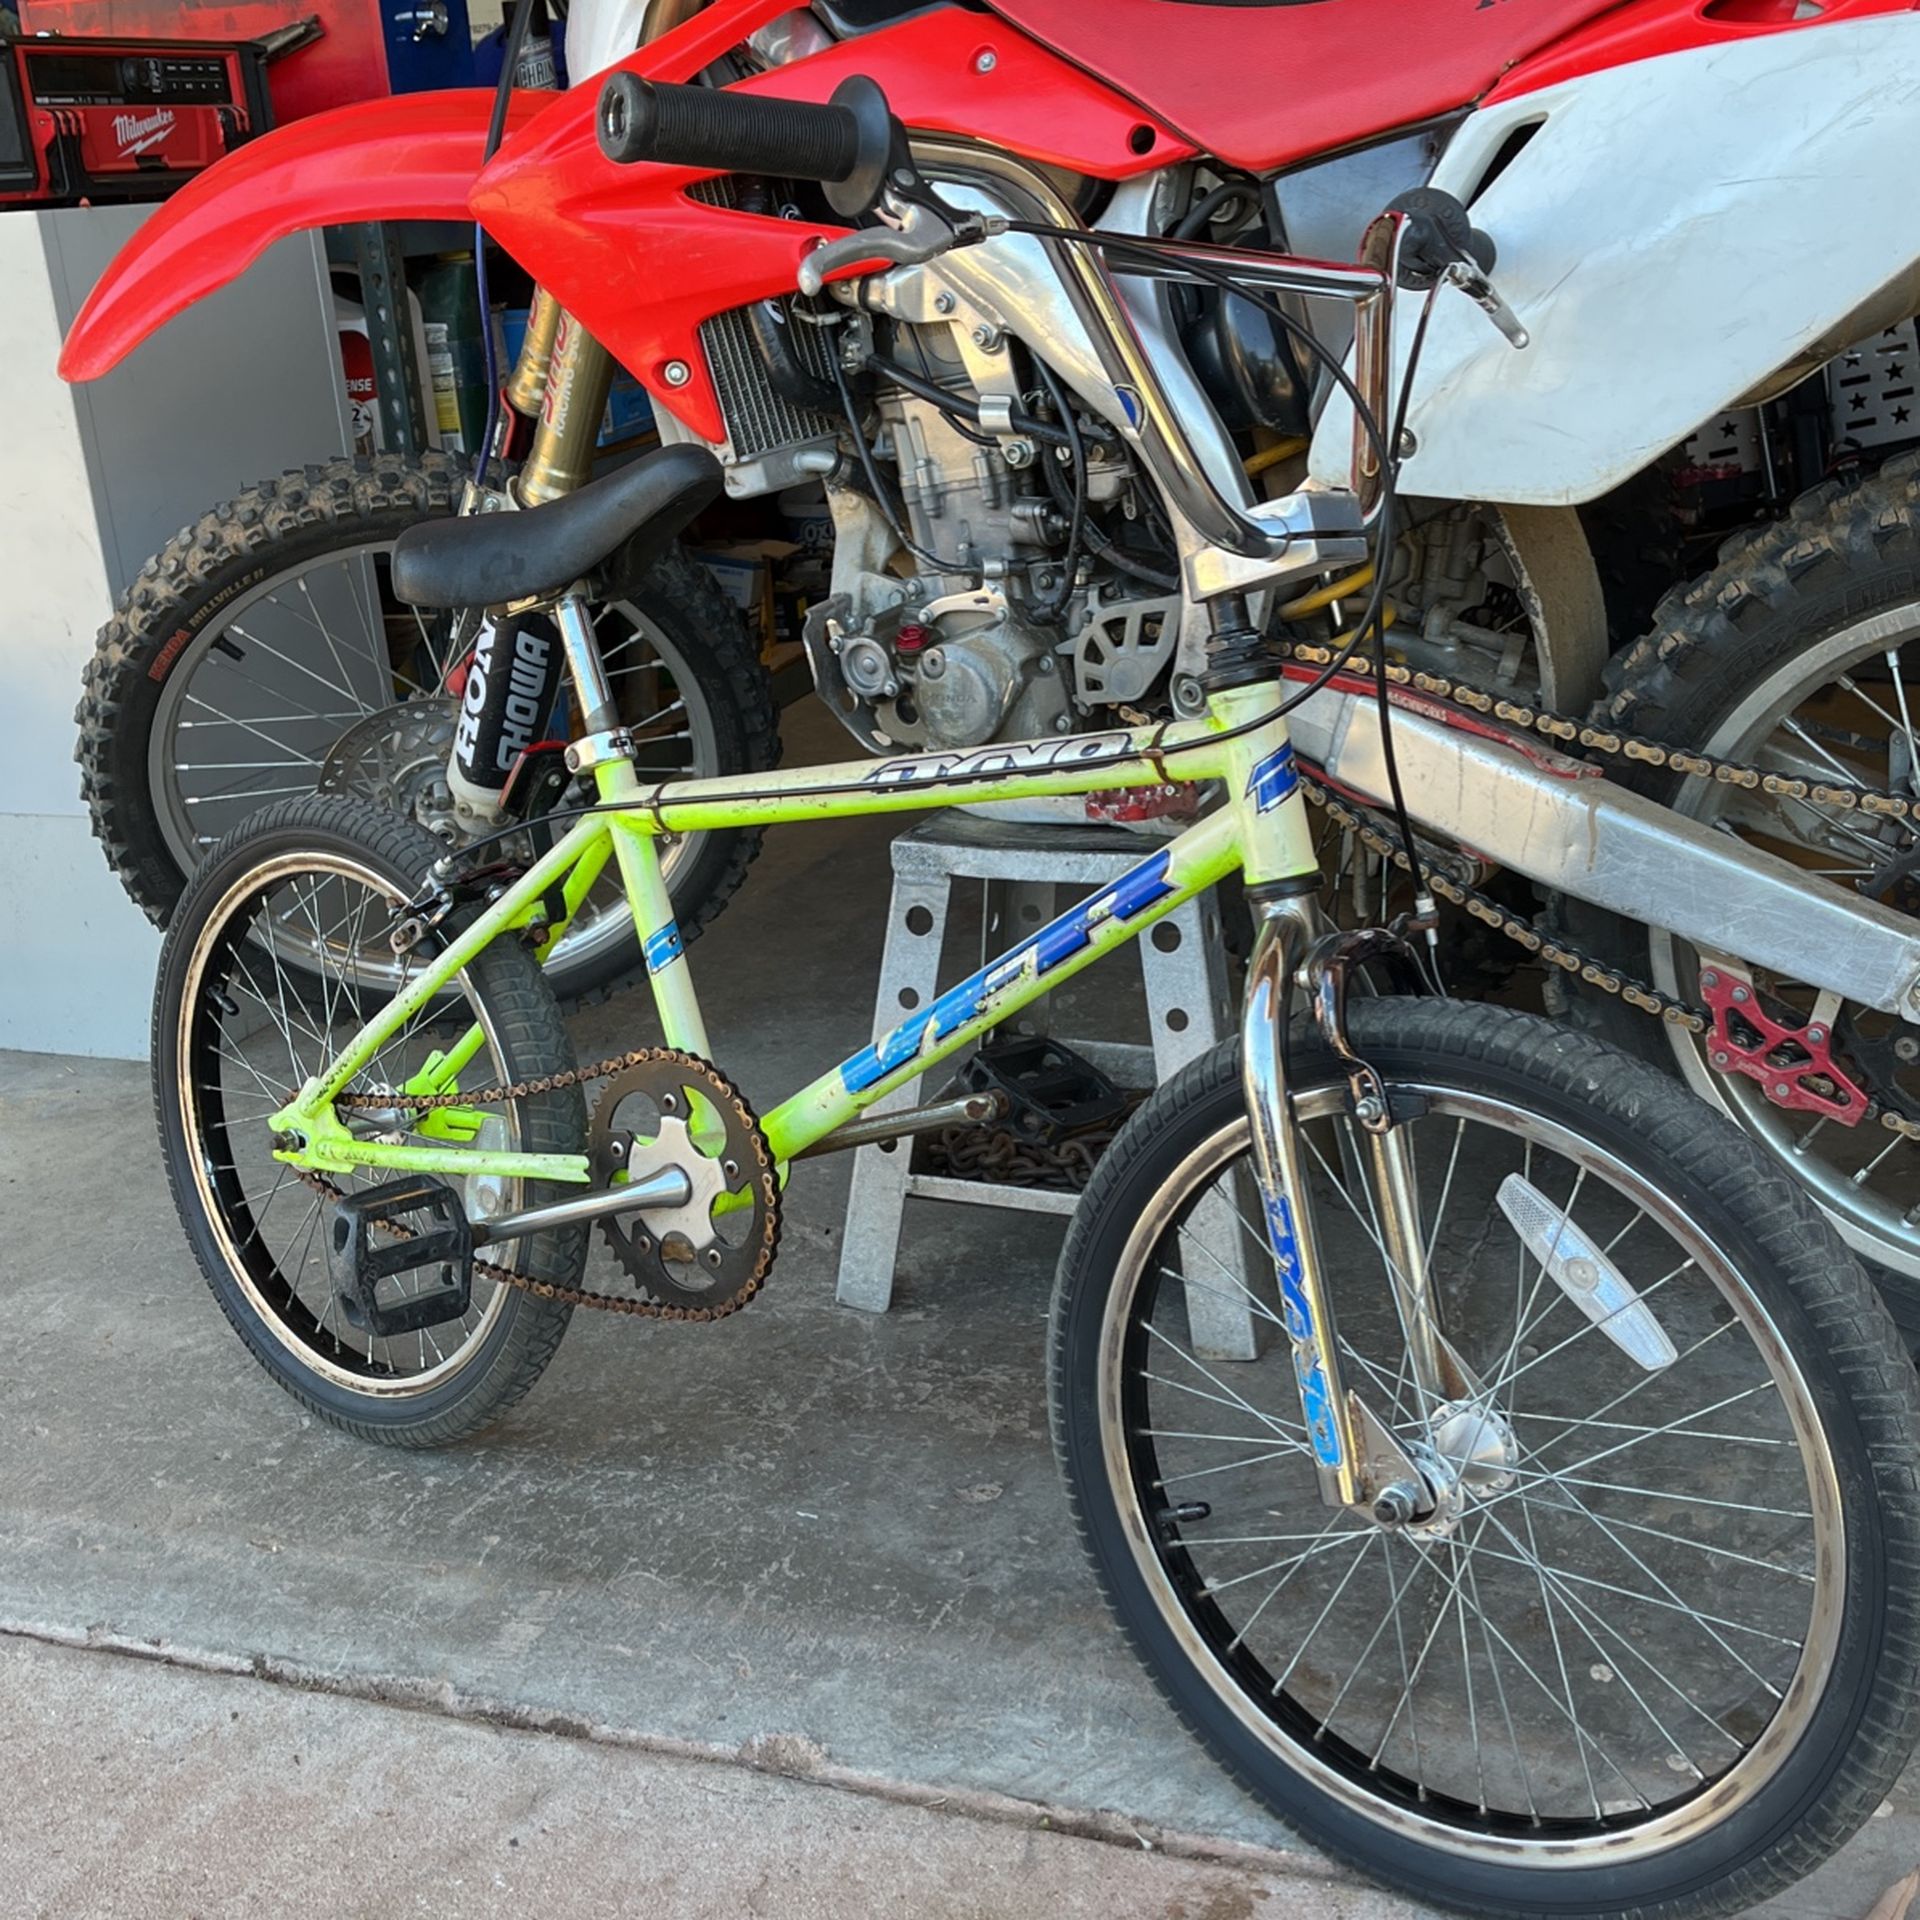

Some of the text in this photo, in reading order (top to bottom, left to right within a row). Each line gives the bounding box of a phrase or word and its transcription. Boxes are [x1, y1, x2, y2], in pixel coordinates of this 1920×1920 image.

[111, 107, 176, 146] Milwaukee
[346, 378, 373, 392] ENSE
[147, 628, 192, 682] KENDA
[188, 575, 252, 628] MILLVILLE
[455, 611, 497, 769] HON
[496, 630, 550, 772] SHOWA
